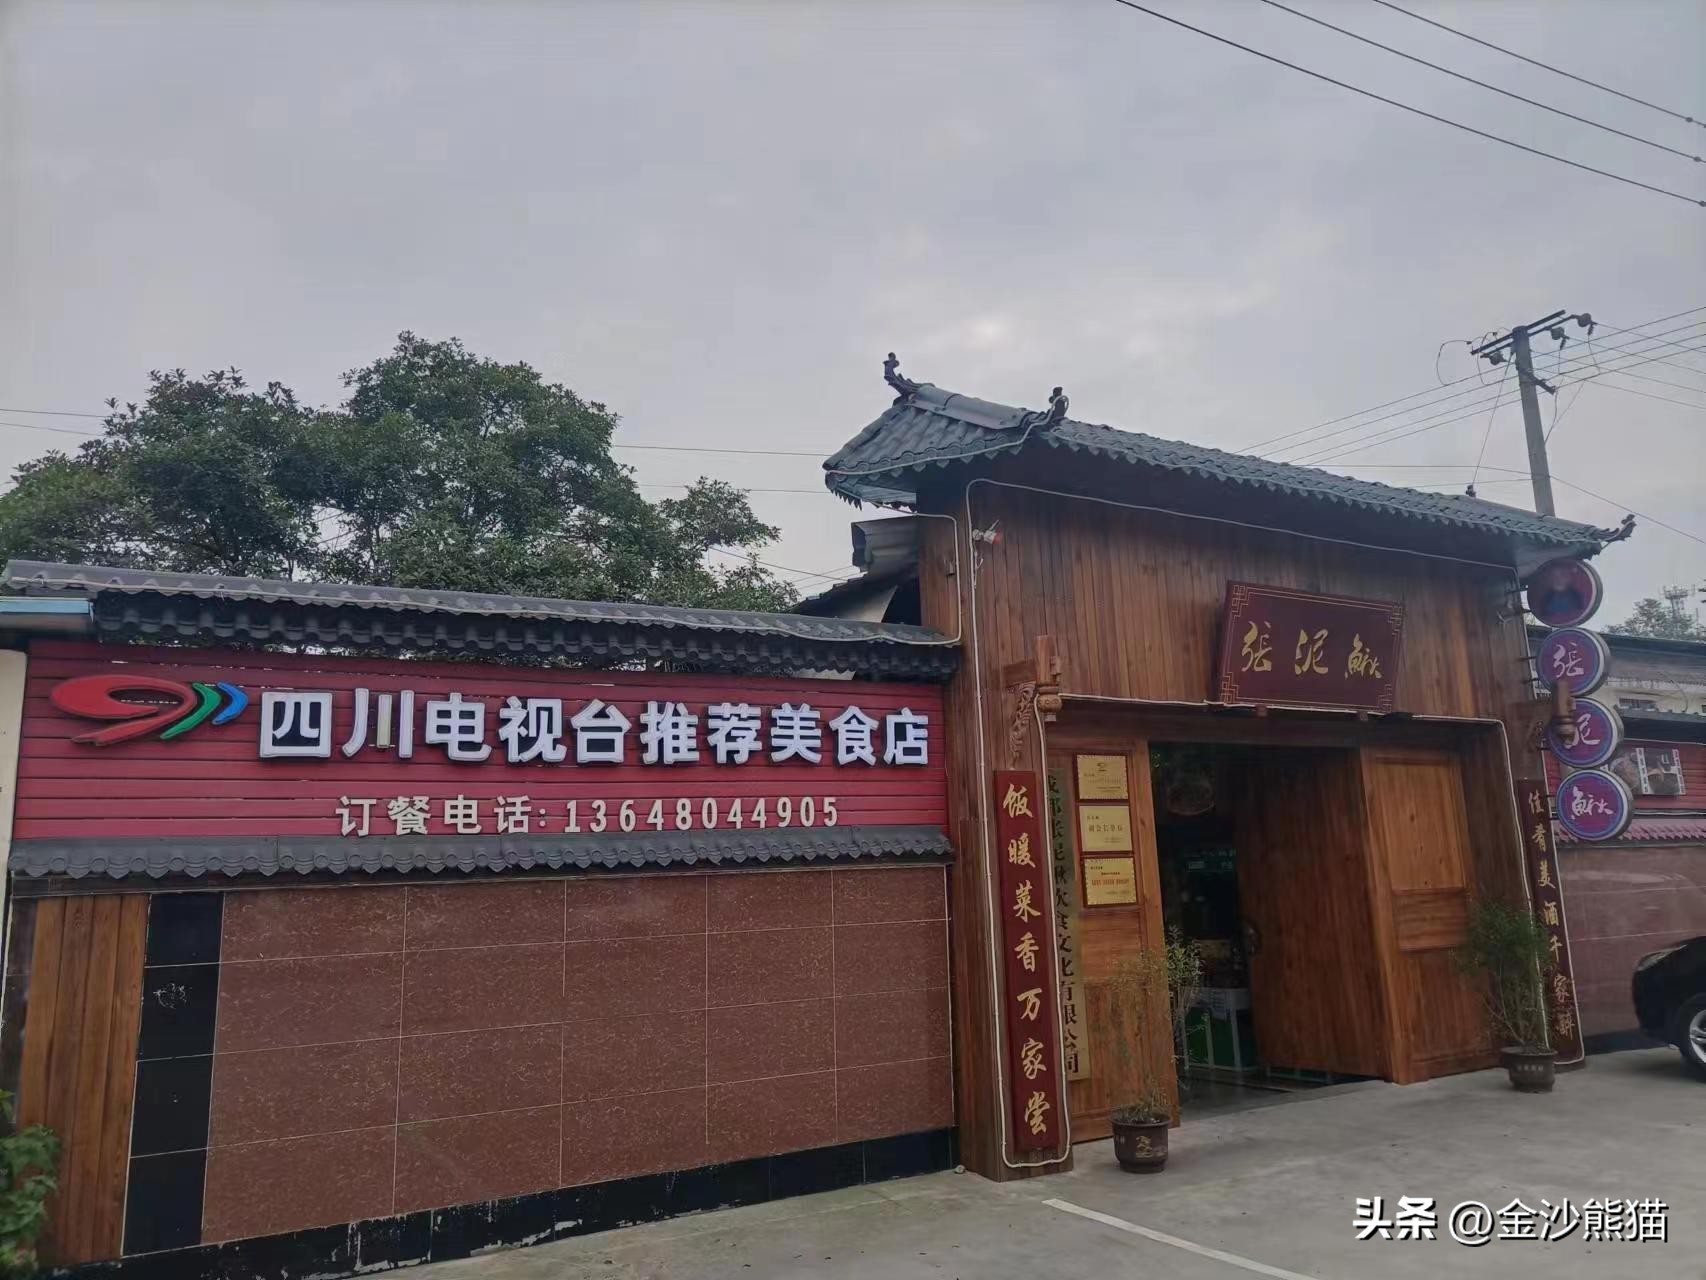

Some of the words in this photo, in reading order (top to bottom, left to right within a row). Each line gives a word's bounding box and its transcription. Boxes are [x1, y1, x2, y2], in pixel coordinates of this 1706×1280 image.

[260, 687, 929, 766] 四川电视台推荐美食店
[1003, 783, 1050, 1136] 饭暖菜香万家尝
